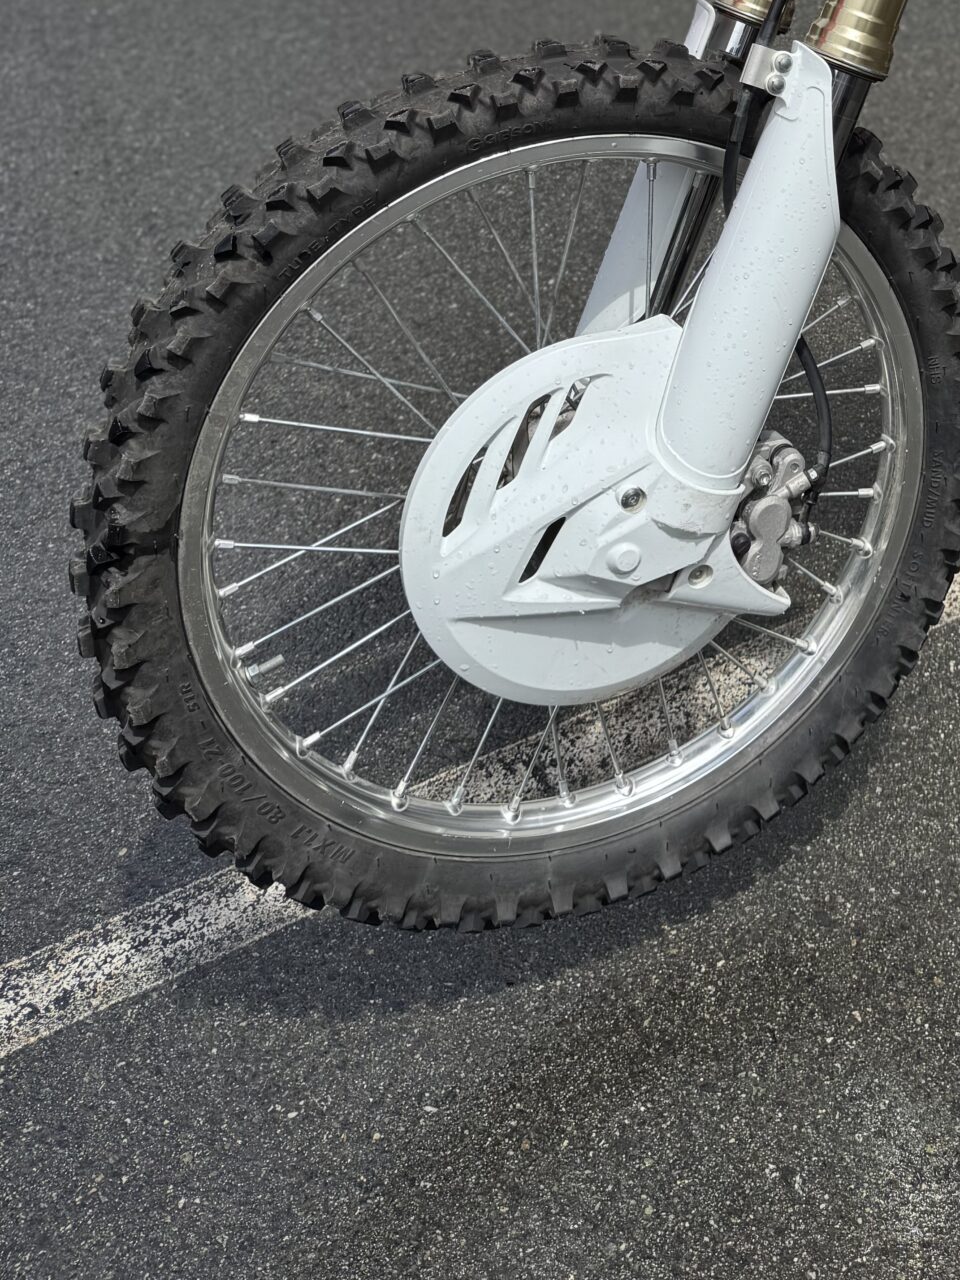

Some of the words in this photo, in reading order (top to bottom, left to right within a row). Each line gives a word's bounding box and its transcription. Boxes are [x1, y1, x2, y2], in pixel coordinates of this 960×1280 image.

[328, 198, 376, 234] TYPE
[928, 354, 942, 385] NHS
[922, 449, 944, 529] SAND/MUD
